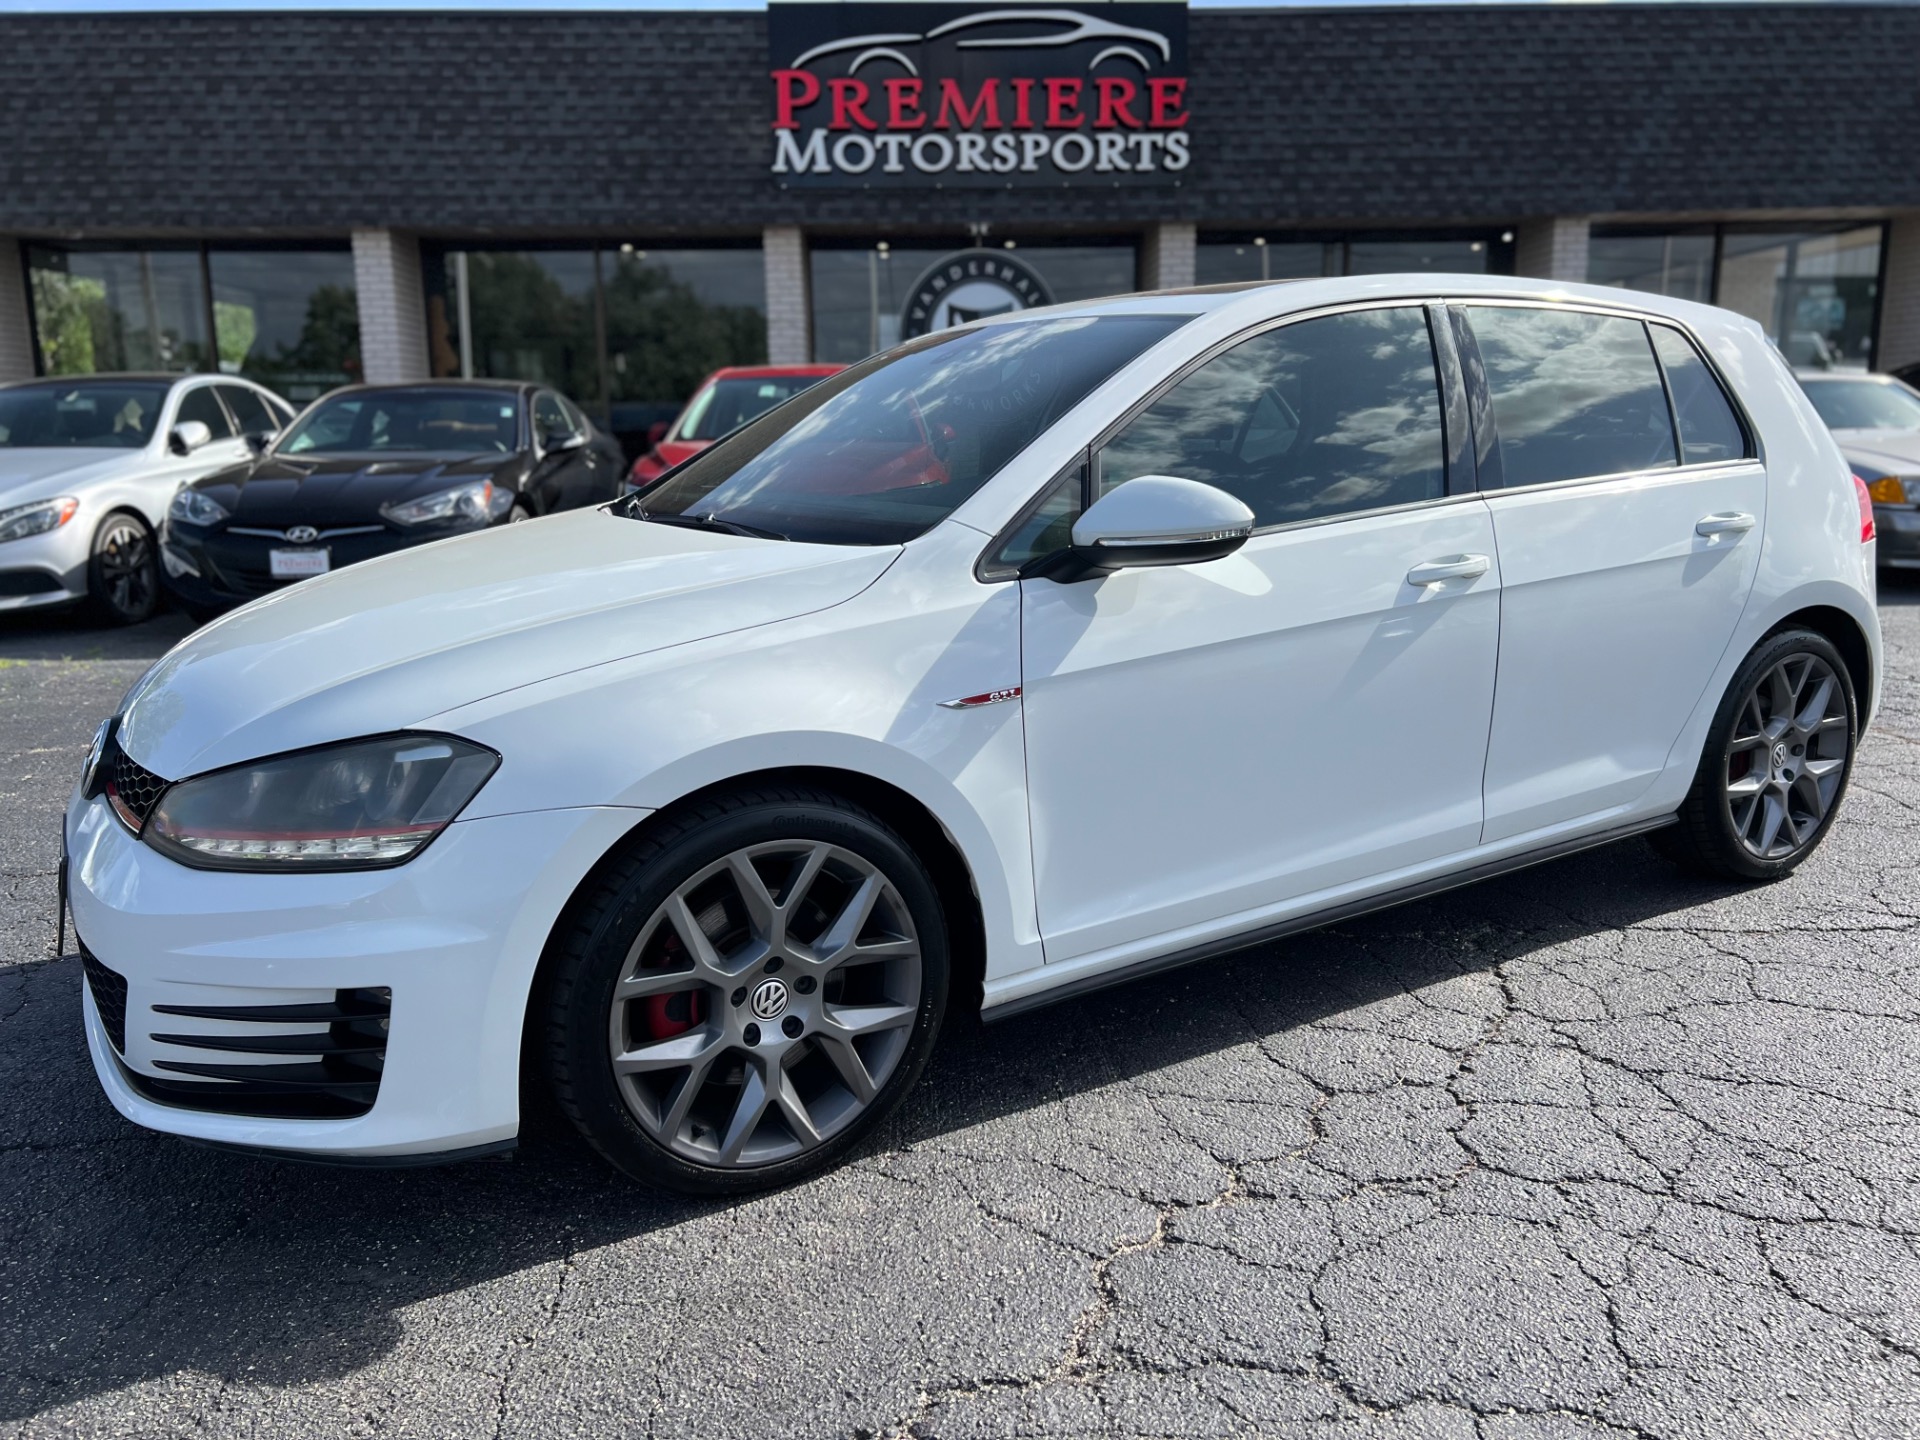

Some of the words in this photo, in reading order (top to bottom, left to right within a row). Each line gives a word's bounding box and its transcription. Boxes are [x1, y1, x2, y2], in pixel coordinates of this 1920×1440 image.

[771, 69, 1190, 129] PREMIERE
[771, 129, 1190, 173] MOTORSPORTS
[990, 688, 1016, 702] GTI
